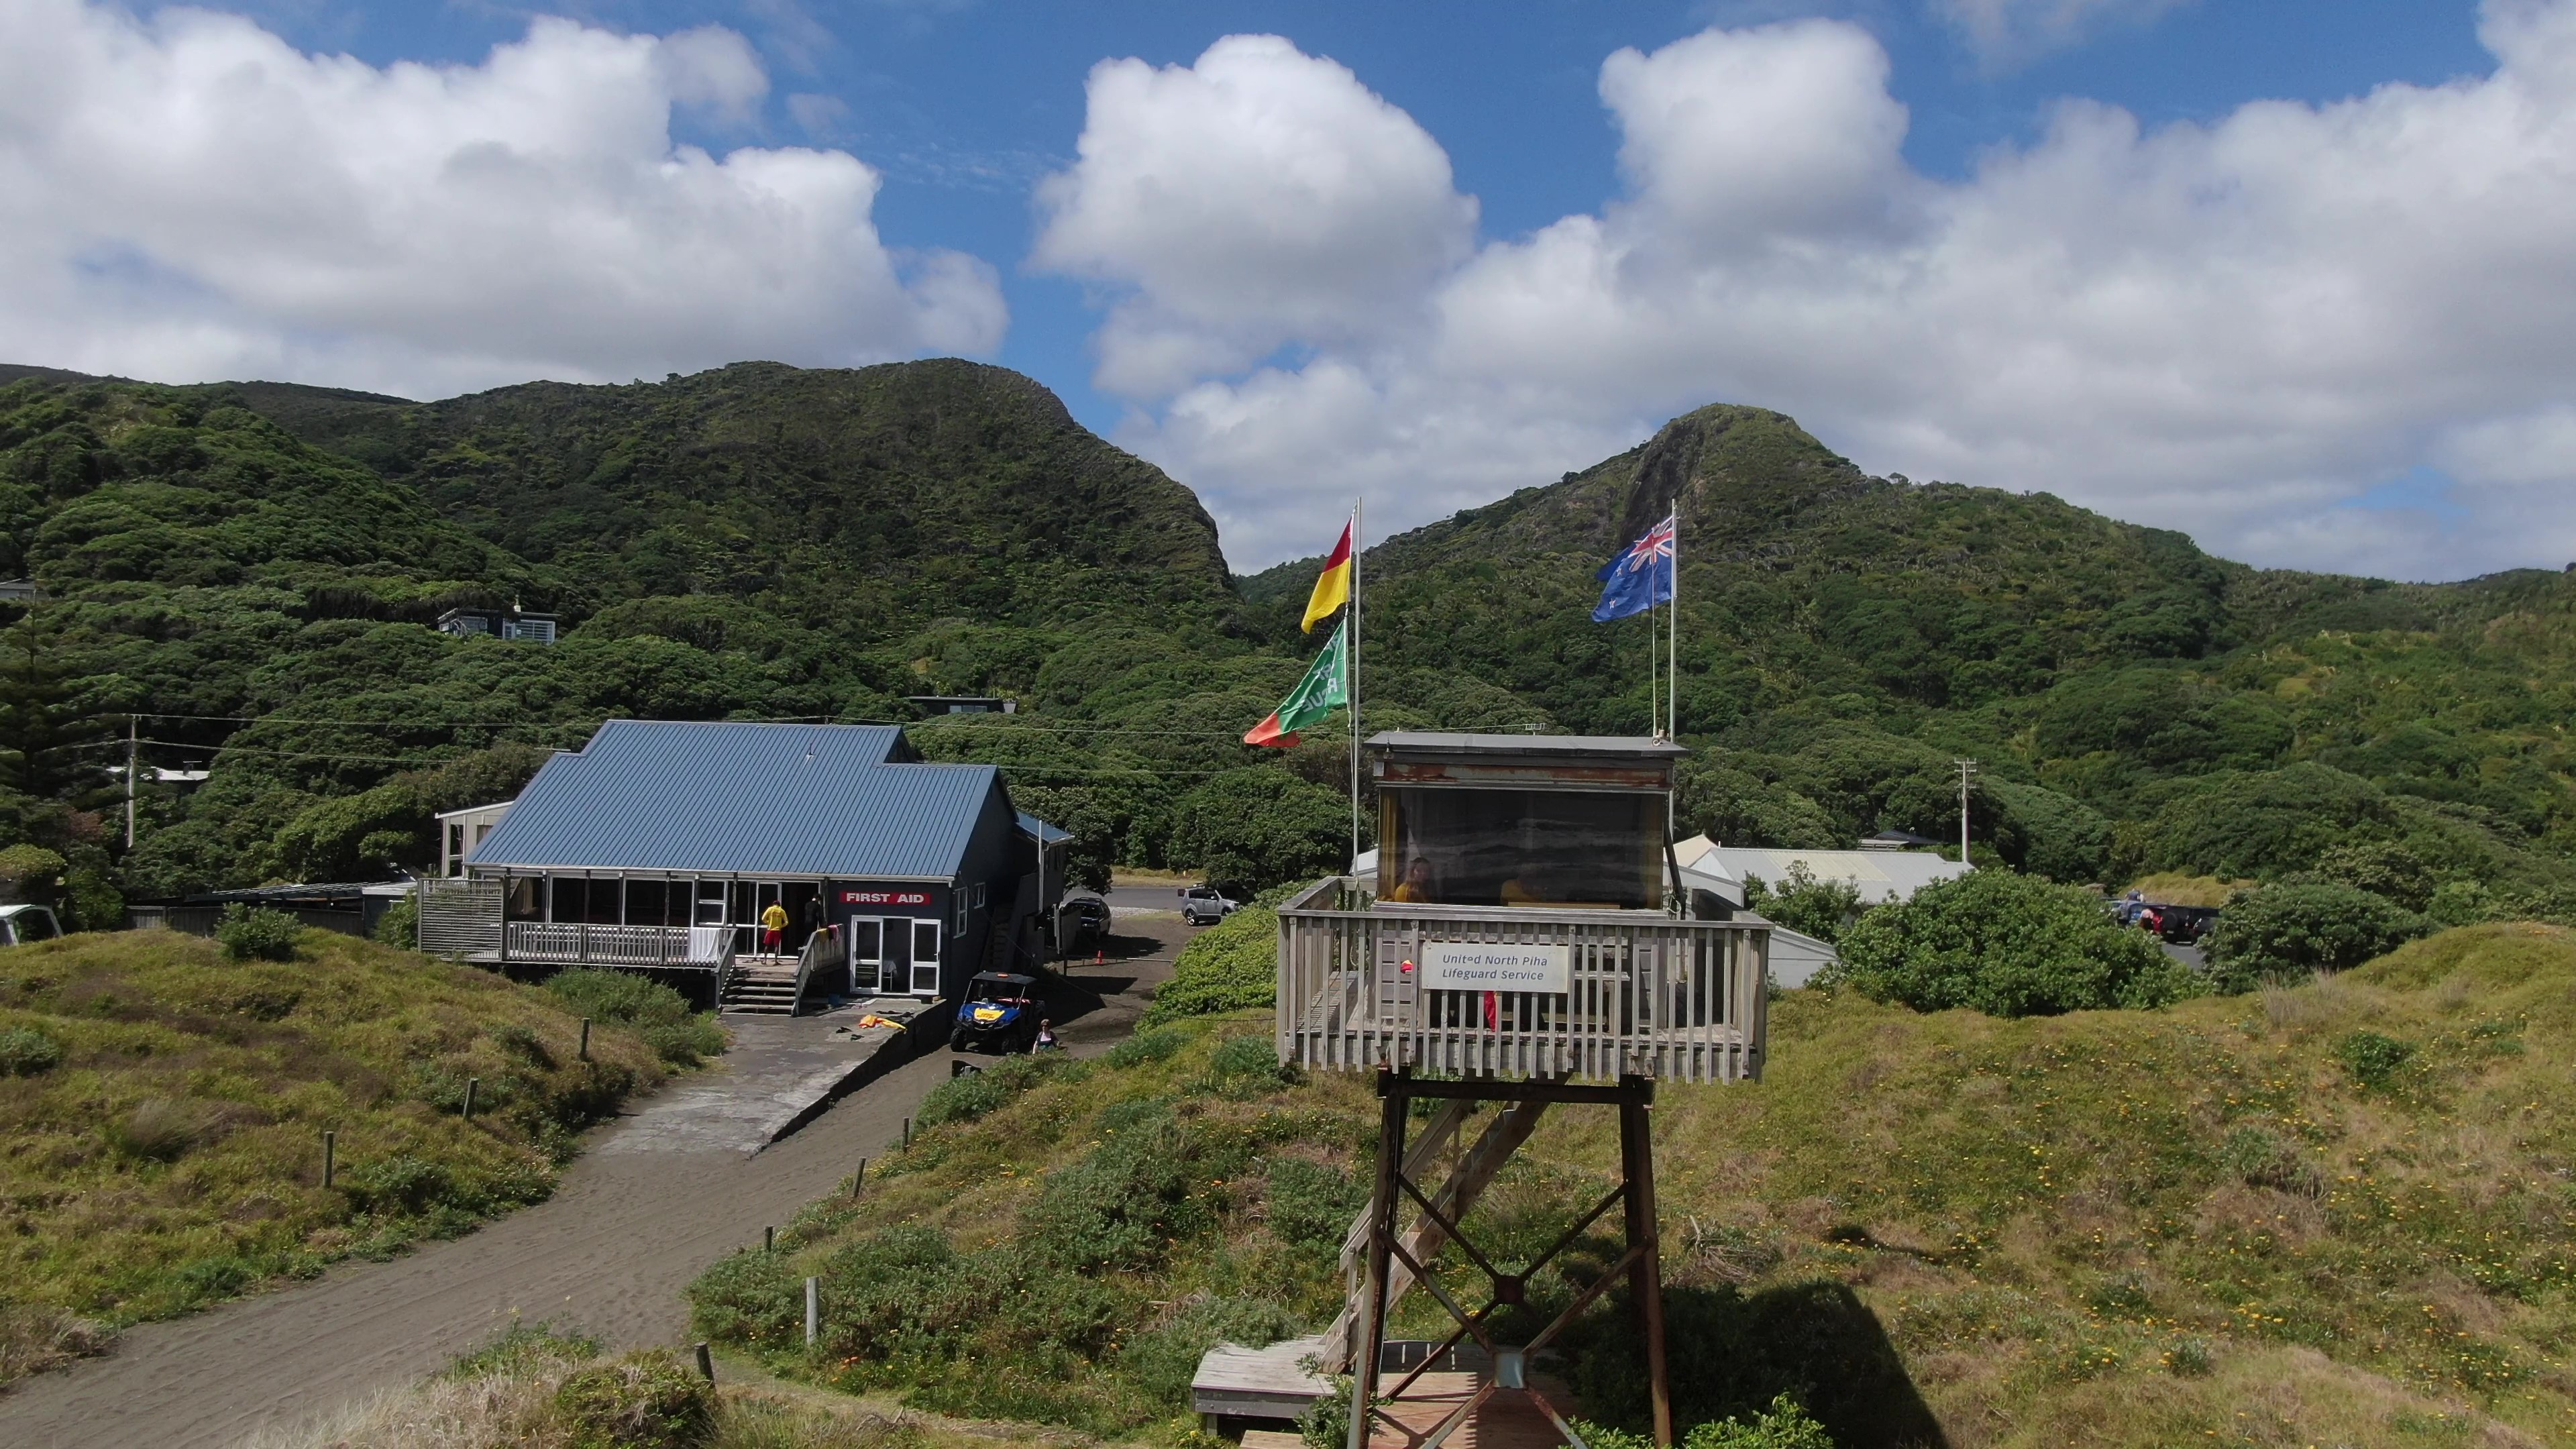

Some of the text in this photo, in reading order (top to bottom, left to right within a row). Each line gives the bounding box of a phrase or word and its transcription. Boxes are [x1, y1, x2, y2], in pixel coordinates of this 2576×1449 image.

[846, 892, 924, 903] FIRST AID
[1442, 954, 1548, 967] United North Piha
[1442, 968, 1544, 981] Lifeguard Service
